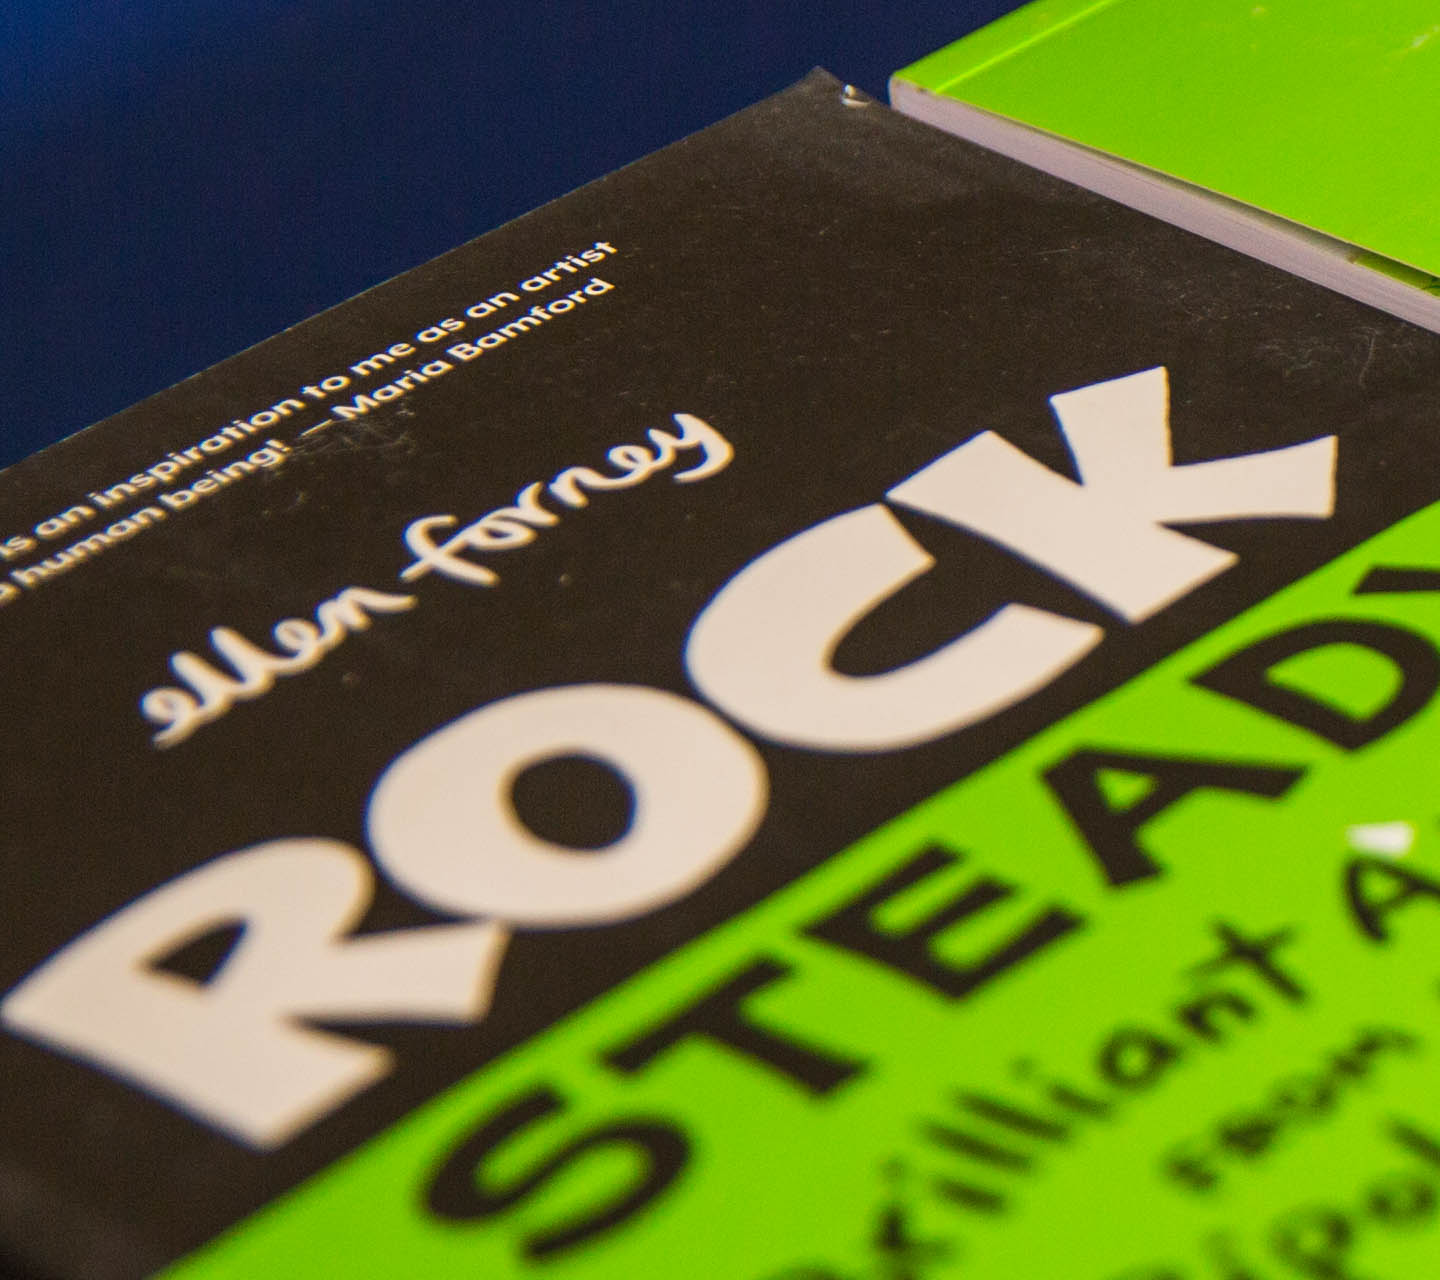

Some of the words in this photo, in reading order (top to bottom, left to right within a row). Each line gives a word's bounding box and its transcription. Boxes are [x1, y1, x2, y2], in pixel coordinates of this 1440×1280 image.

[9, 506, 168, 589] human
[159, 438, 293, 510] being!
[446, 277, 615, 363] Bamford
[33, 505, 97, 540] an
[88, 395, 305, 510] inspiration
[301, 374, 351, 400] to
[349, 342, 416, 377] me
[416, 315, 466, 343] as
[465, 290, 521, 319] an
[519, 239, 618, 291] artist
[141, 586, 416, 749] ellen
[400, 413, 736, 587] forney
[0, 364, 1339, 1151] ROCK
[1164, 1015, 1425, 1195] FROM
